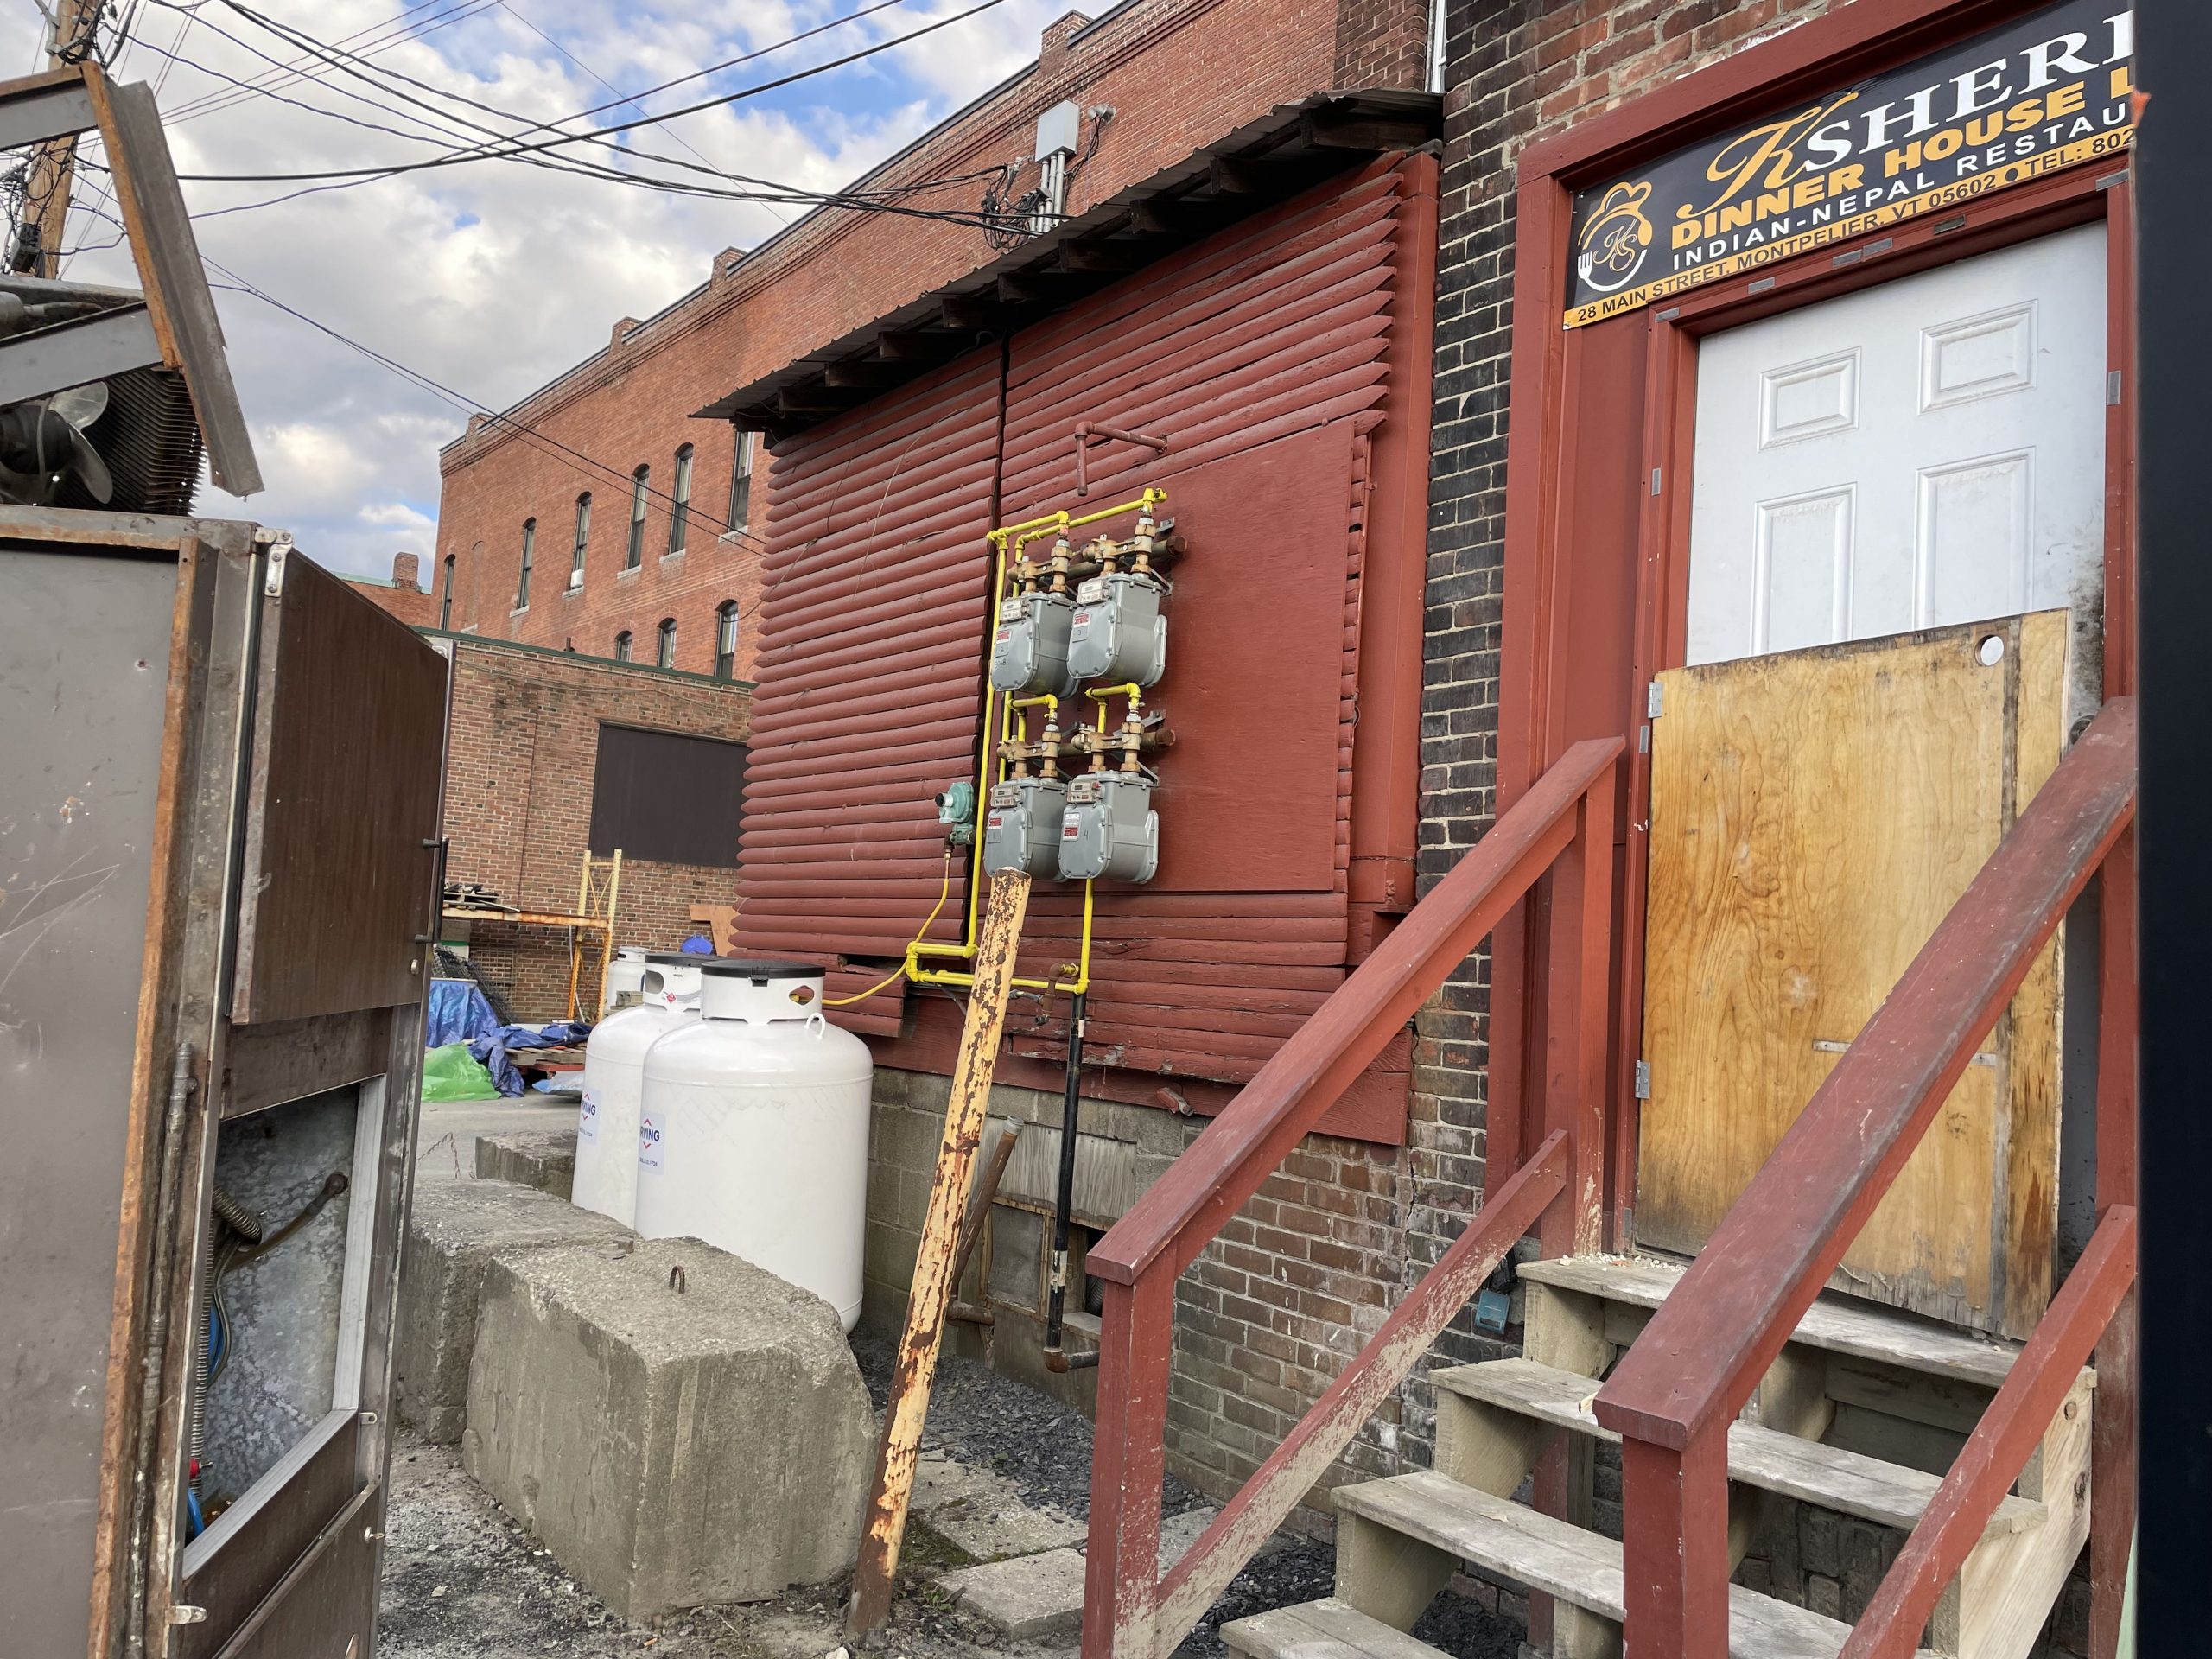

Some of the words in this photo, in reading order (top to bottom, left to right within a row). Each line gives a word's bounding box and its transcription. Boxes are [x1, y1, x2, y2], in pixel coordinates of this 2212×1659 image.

[1578, 305, 1597, 322] 28
[1602, 289, 1646, 315] MAIN
[1892, 198, 1921, 217] VT
[1929, 174, 1996, 207] 05602
[2025, 145, 2082, 175] TEL:
[1671, 163, 1865, 251] DINNER
[1884, 80, 2086, 179] HOUSE
[1674, 172, 1935, 271] INDIAN-NEPAL
[1956, 103, 2126, 176] RESTAU
